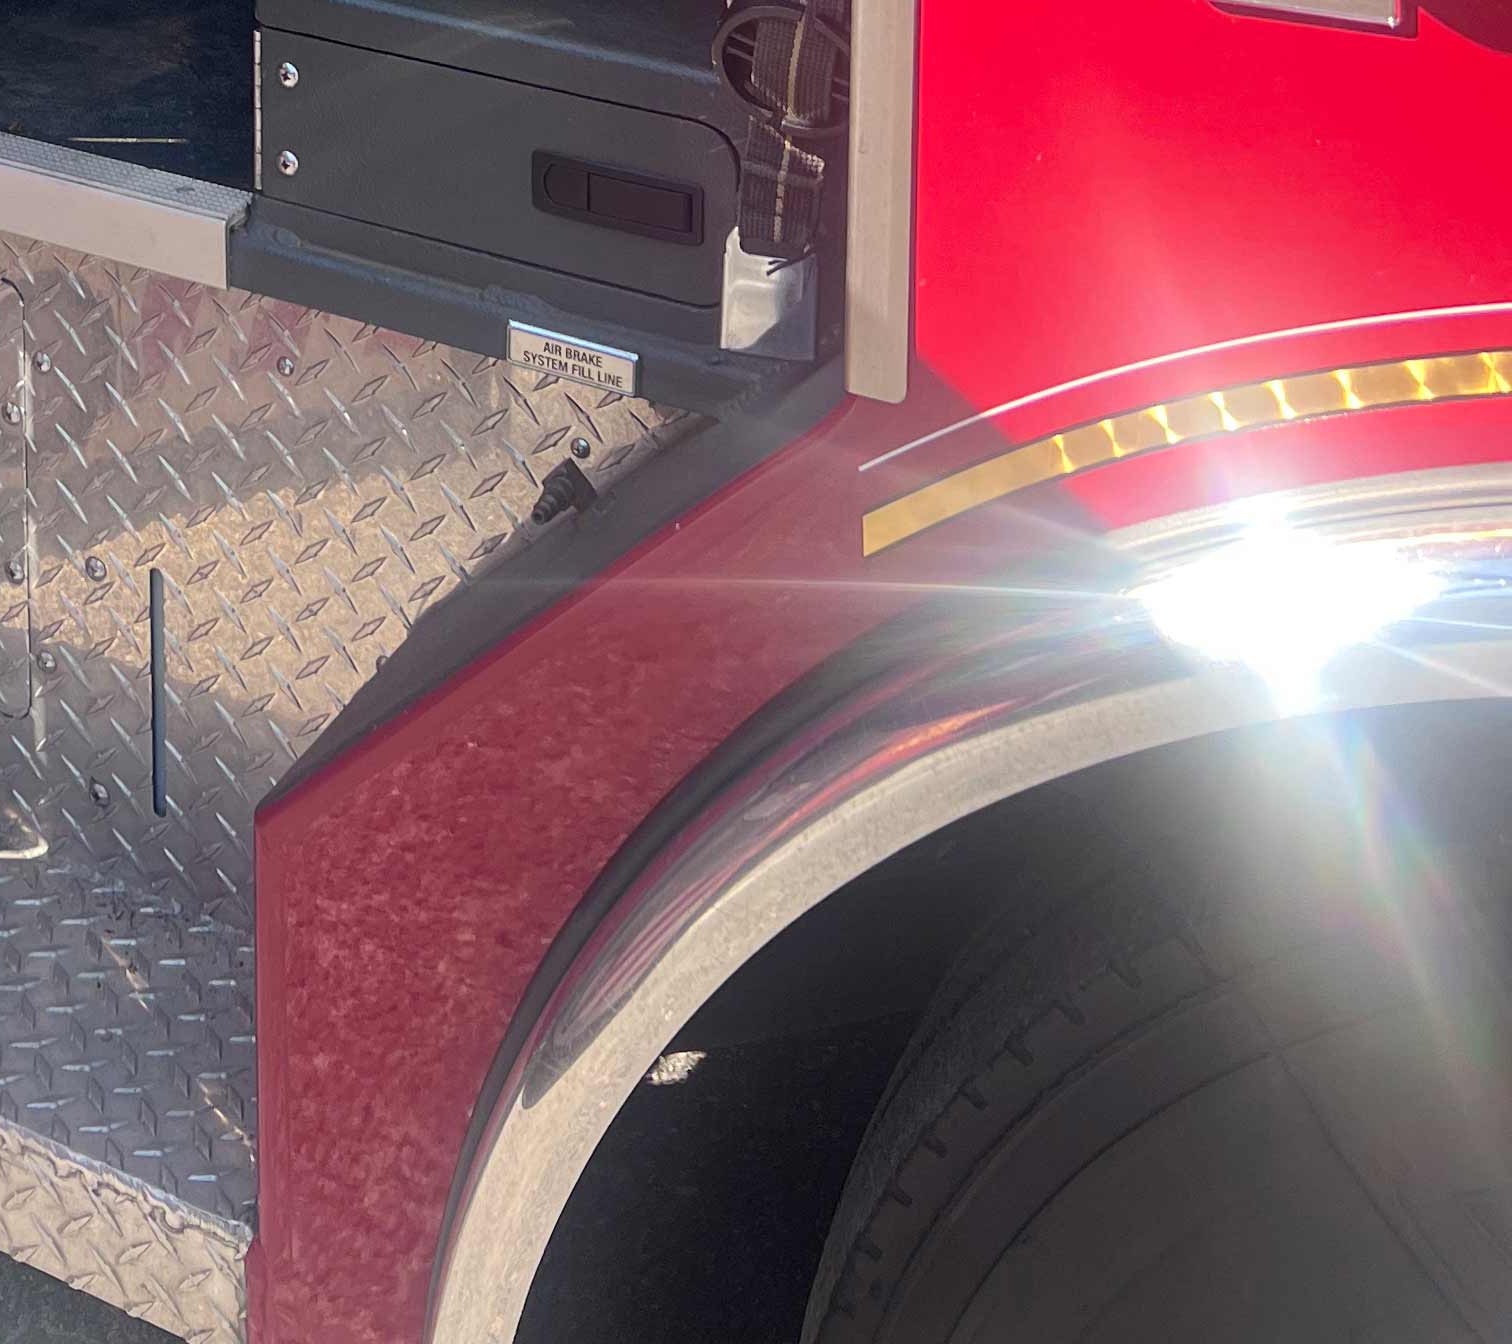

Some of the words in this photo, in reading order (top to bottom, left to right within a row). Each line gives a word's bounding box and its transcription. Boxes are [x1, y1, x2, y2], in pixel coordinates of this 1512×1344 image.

[523, 350, 568, 372] SYSTEM
[572, 364, 595, 381] FILL
[597, 370, 623, 388] LINE
[543, 342, 562, 357] AIR
[565, 348, 602, 368] BRAKE
